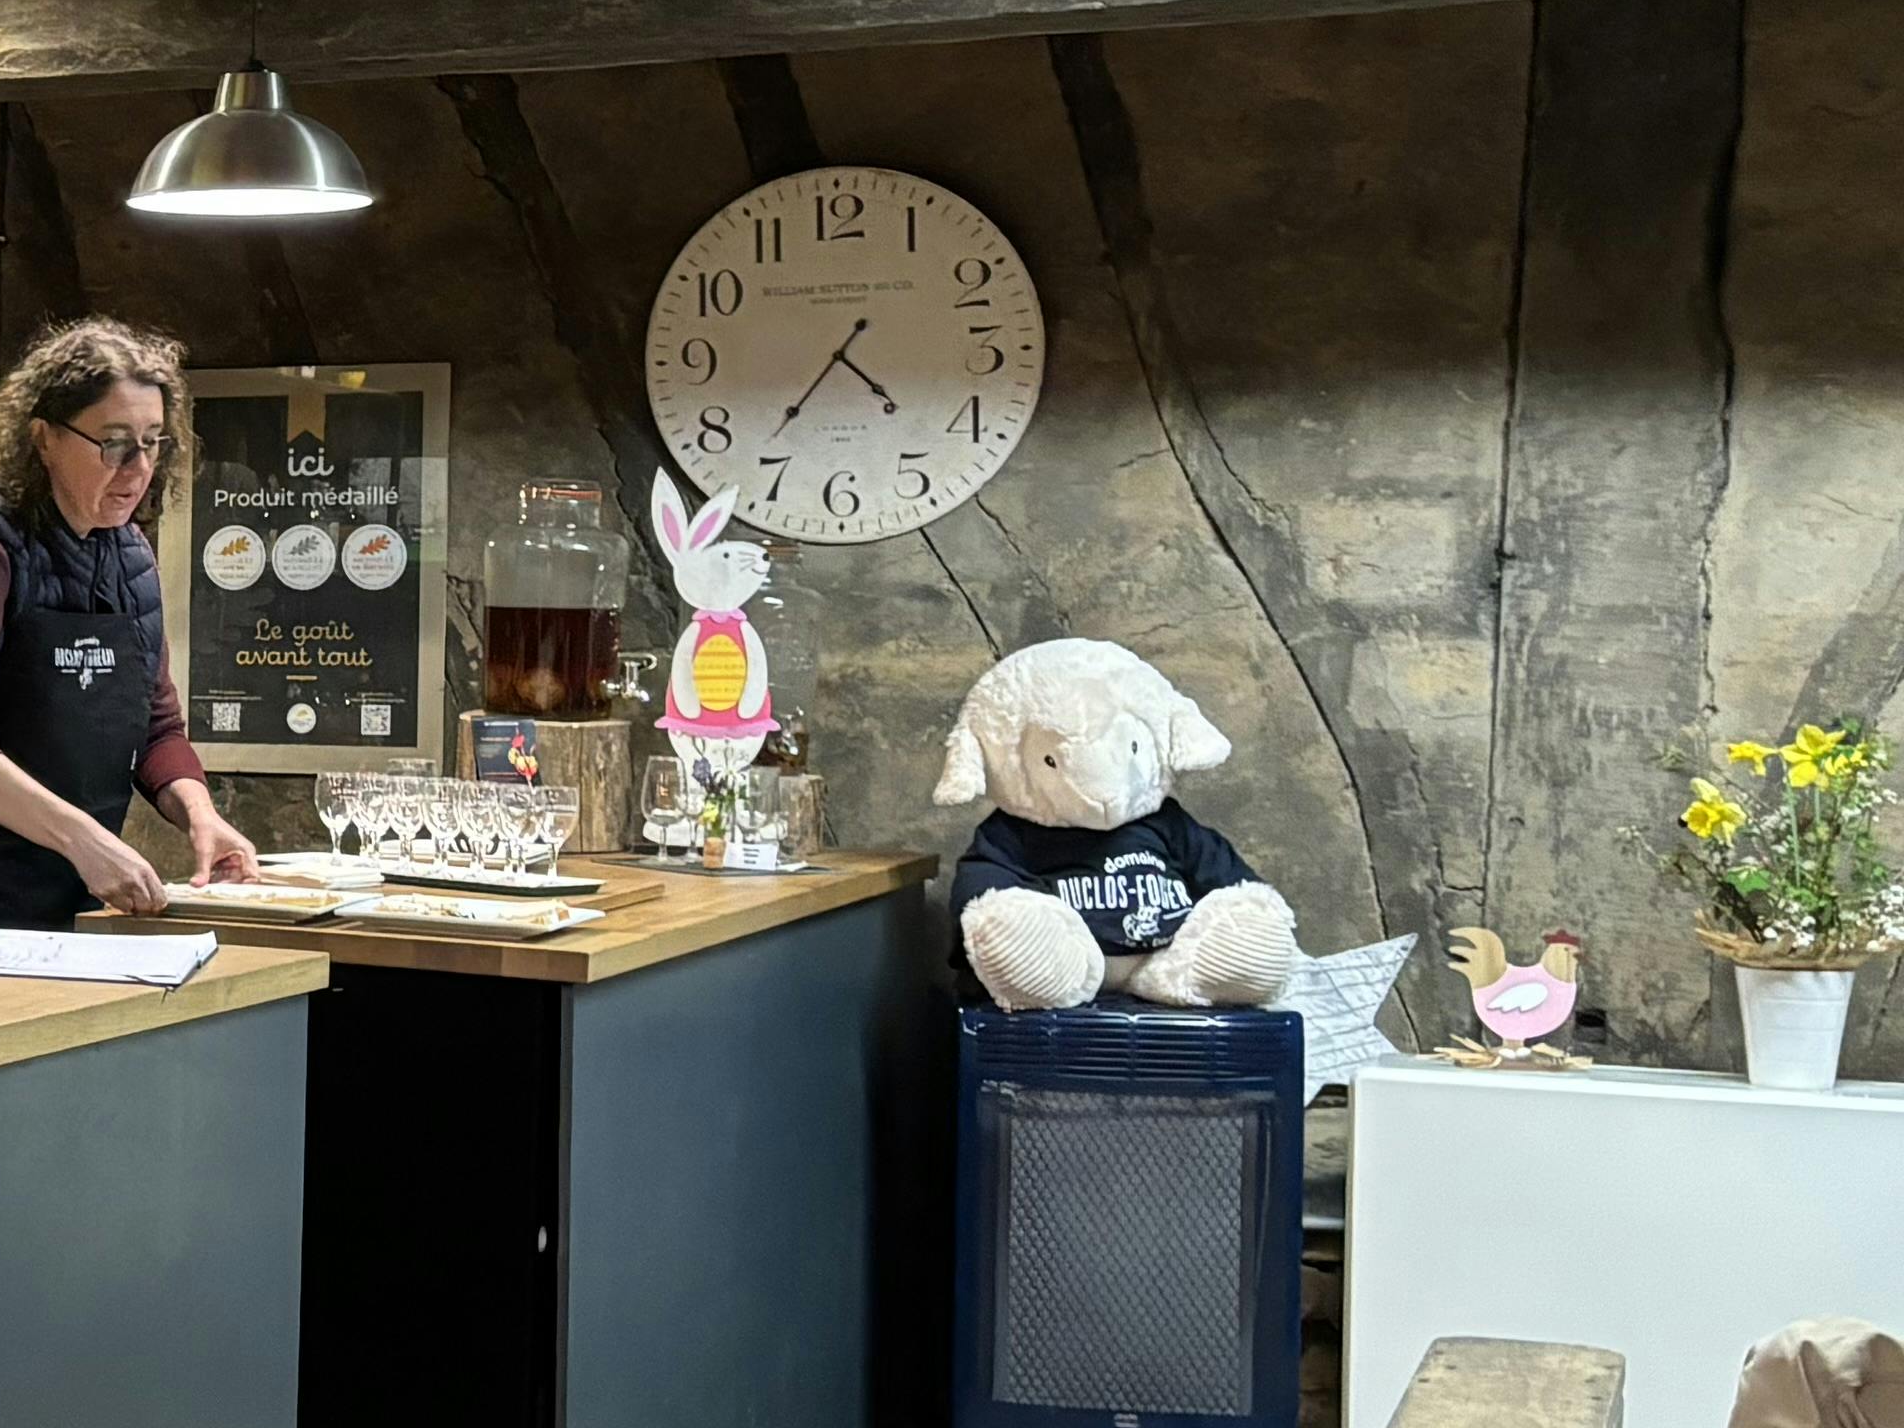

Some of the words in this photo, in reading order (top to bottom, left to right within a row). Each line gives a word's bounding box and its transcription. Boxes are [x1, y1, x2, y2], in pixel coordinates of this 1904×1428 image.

[754, 217, 782, 264] 11
[816, 193, 865, 242] 12
[906, 206, 916, 253] 1
[698, 269, 744, 317] 10
[953, 258, 992, 308] 2
[681, 338, 718, 386] 9
[965, 324, 1005, 376] 3
[697, 405, 732, 454] 8
[945, 395, 988, 444] 4
[287, 447, 335, 477] ici
[759, 455, 792, 502] 7
[894, 451, 931, 500] 5
[214, 487, 295, 508] Produit
[301, 485, 400, 507] médaillé
[822, 470, 860, 518] 6
[254, 618, 283, 641] Le
[292, 620, 355, 647] goût
[236, 647, 312, 667] avant
[318, 647, 373, 667] tout
[1103, 850, 1166, 874] domaine
